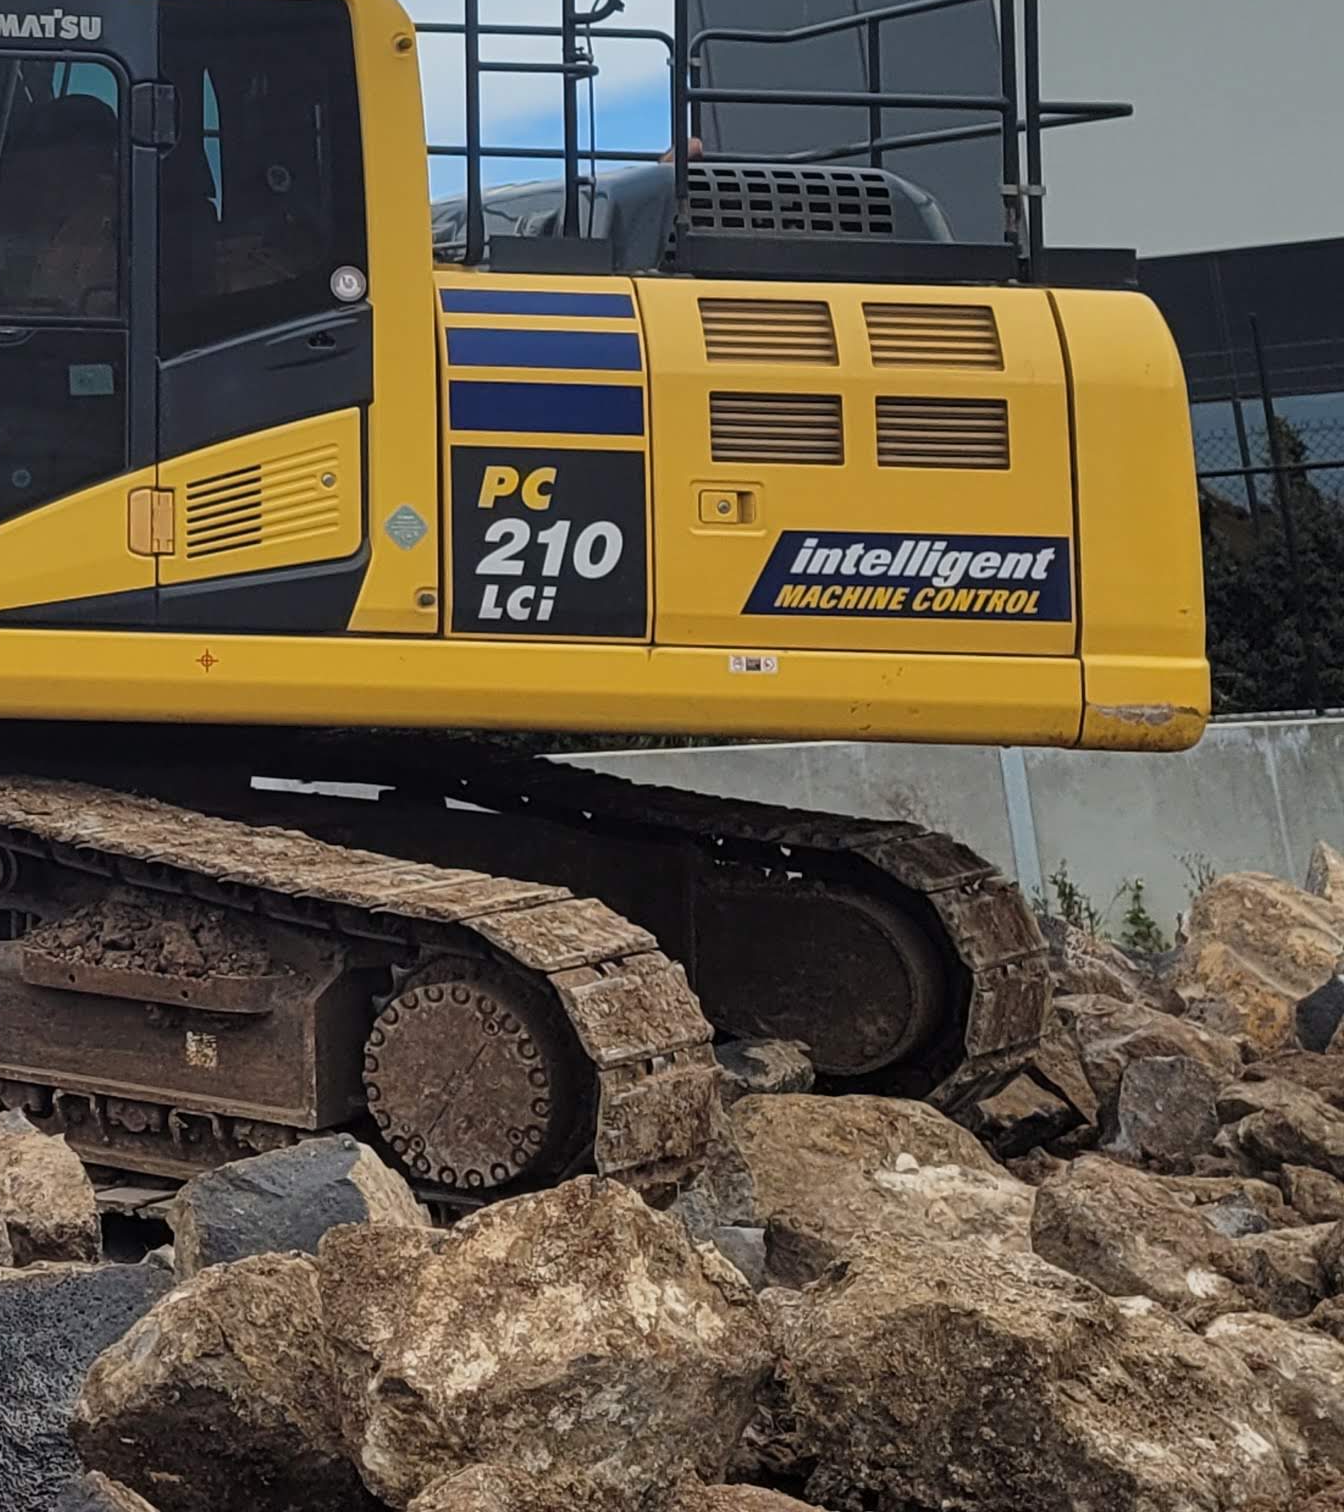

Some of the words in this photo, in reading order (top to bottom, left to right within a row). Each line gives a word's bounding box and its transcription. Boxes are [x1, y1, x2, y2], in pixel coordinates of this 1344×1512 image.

[477, 465, 558, 511] PC
[474, 517, 624, 579] 210
[789, 538, 1056, 588] intelligent
[477, 584, 558, 621] LCi
[773, 584, 910, 611] MACHINE
[912, 587, 1040, 614] CONTROL
